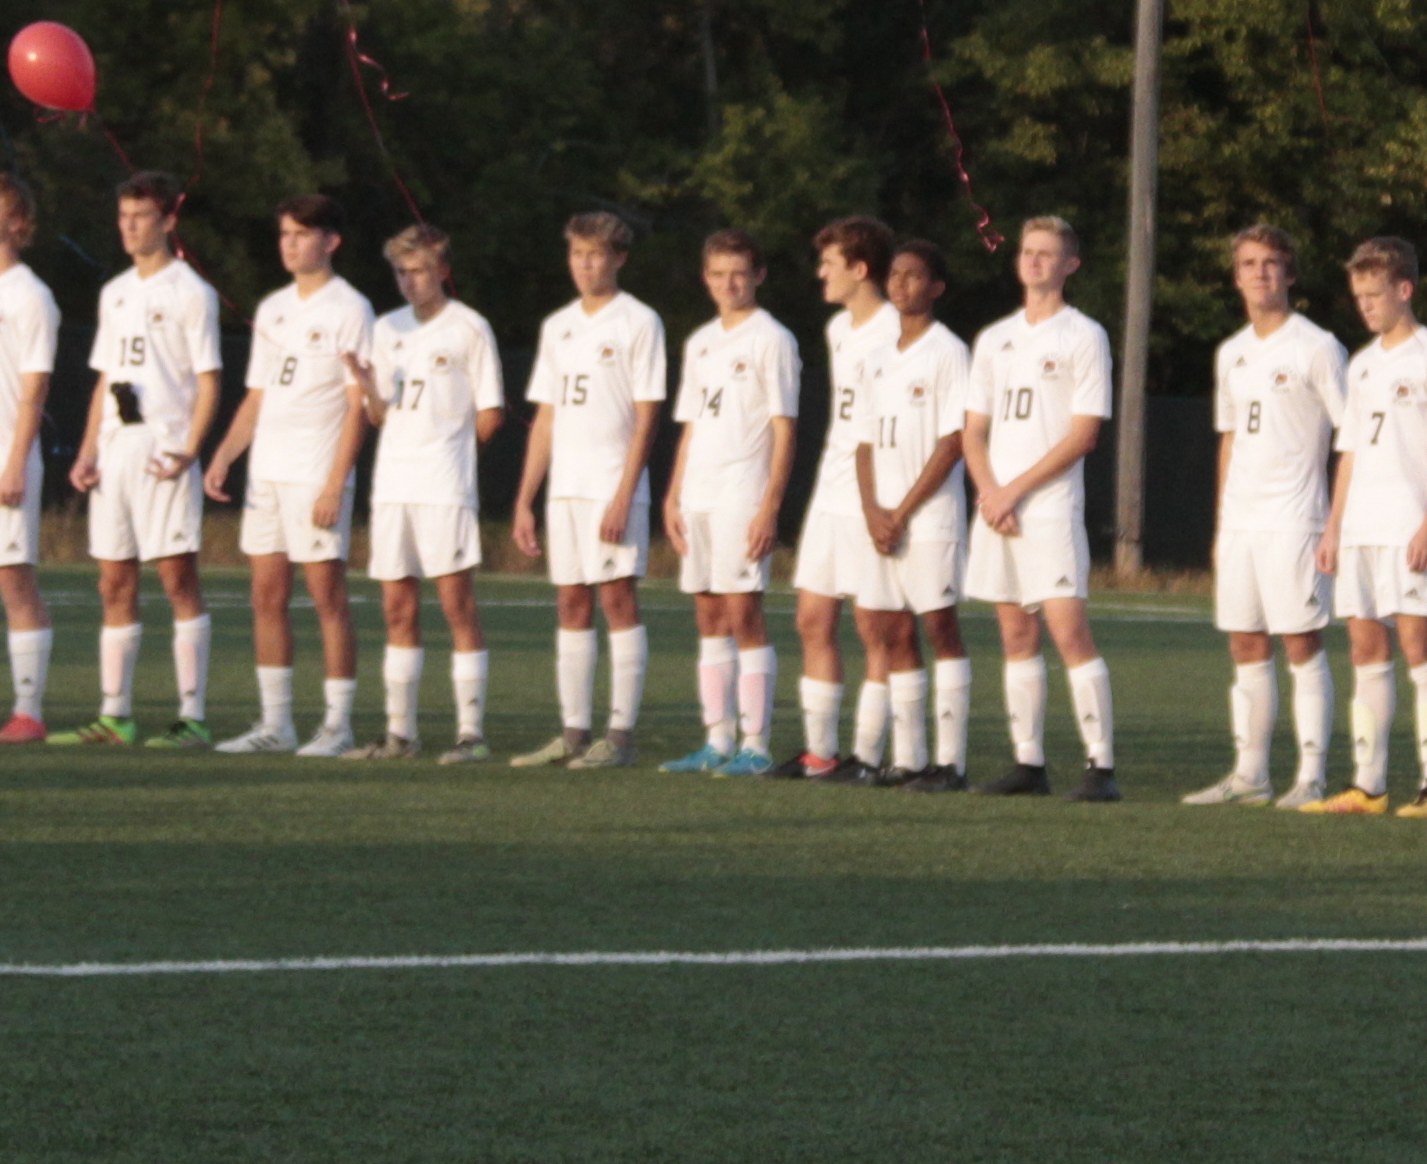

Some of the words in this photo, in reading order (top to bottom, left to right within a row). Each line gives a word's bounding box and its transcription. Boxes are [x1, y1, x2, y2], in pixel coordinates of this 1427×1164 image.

[119, 337, 145, 367] 19
[395, 380, 425, 411] 17
[561, 374, 589, 406] 15
[699, 387, 724, 418] 14
[1003, 387, 1033, 421] 10
[879, 415, 898, 448] 11
[1247, 400, 1262, 434] 8
[1370, 411, 1386, 445] 7
